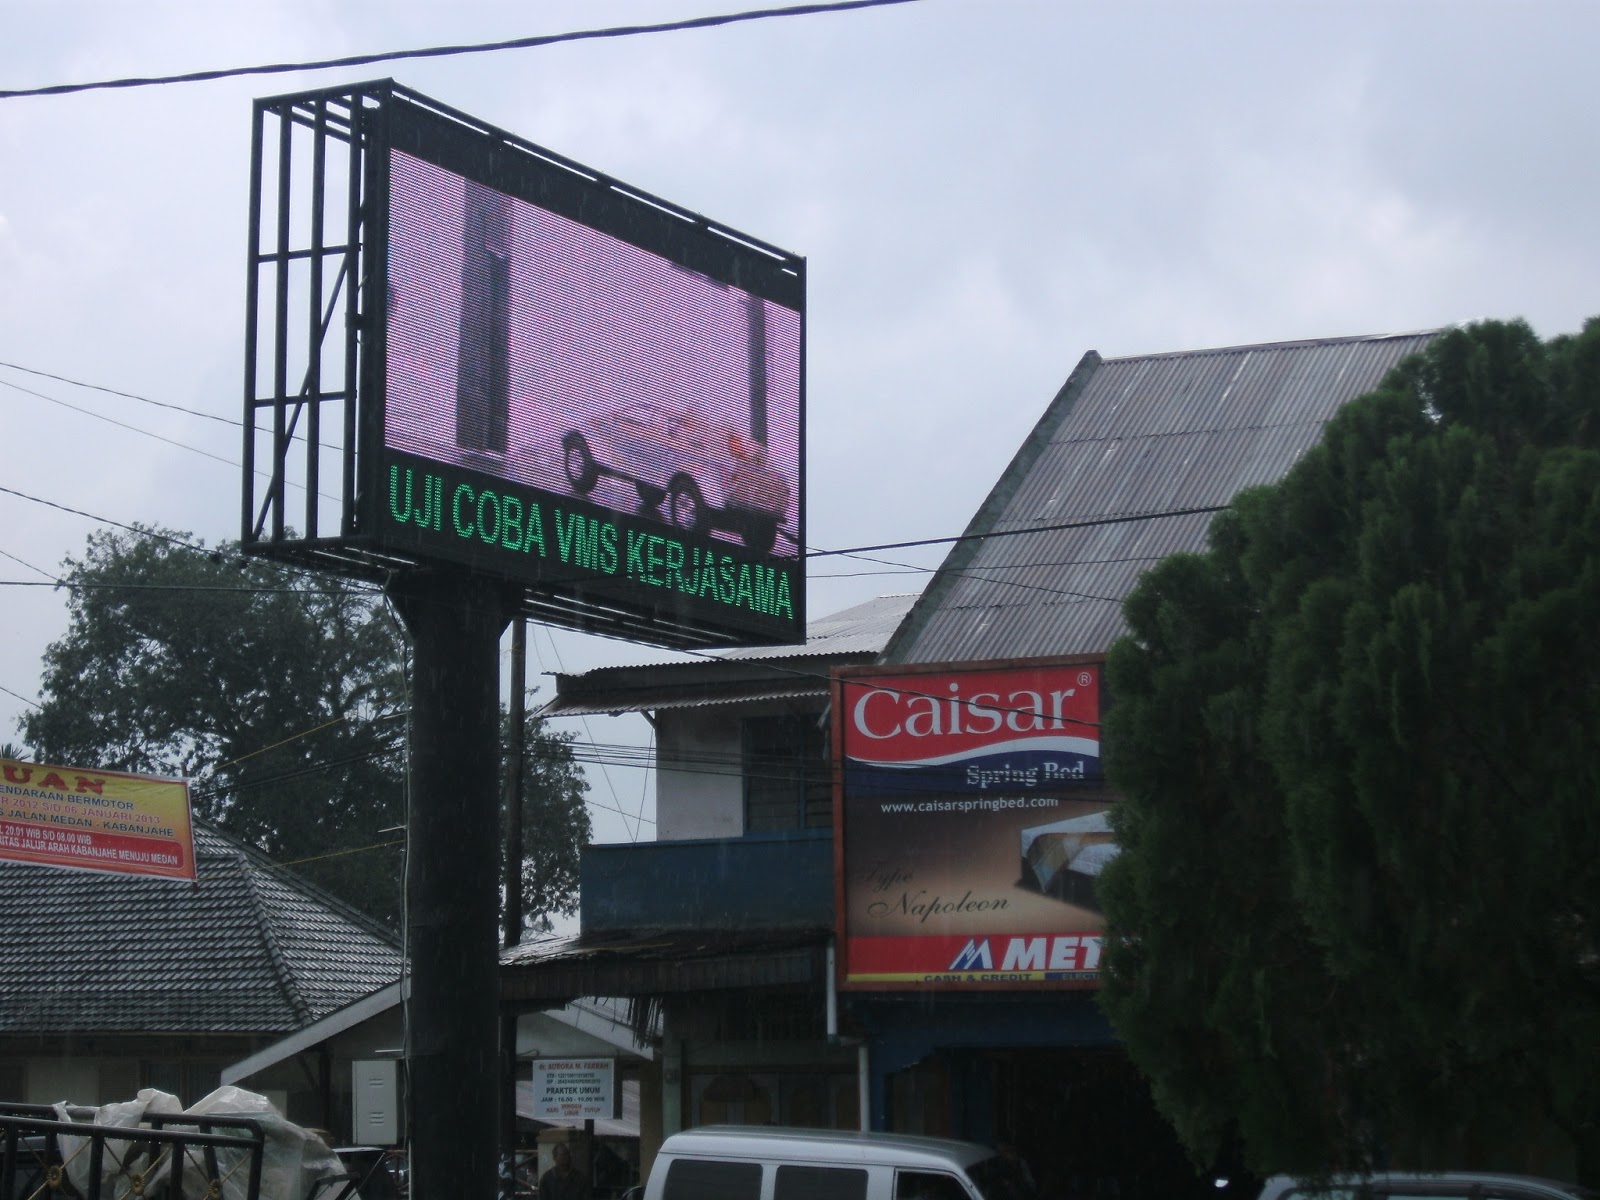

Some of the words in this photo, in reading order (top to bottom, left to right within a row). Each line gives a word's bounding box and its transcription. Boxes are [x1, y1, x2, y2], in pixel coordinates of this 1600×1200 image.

[389, 464, 443, 531] UJI
[452, 482, 546, 557] COBA
[554, 507, 618, 575] VMS
[626, 528, 794, 620] KERJASAMA
[853, 682, 1076, 740] Caisar
[966, 763, 1038, 789] Spring
[13, 798, 38, 809] 2012
[42, 802, 61, 813] S/D
[81, 808, 132, 822] JANUARI
[135, 814, 161, 825] 2013
[67, 794, 134, 811] BERMOTOR
[880, 796, 1059, 814] www.caisarspringbed.com
[8, 809, 47, 822] JALAN
[50, 815, 92, 828] MEDAN
[103, 821, 175, 837] KABANJAHE
[26, 828, 41, 840] WIB
[77, 834, 92, 845] WIB
[21, 838, 47, 851] JALUR
[47, 841, 70, 853] ARAH
[70, 844, 117, 860] KABANJAHE
[119, 850, 150, 863] MENUJU
[151, 853, 178, 866] MEDAN
[867, 889, 1010, 924] Napoleon
[924, 974, 962, 983] CASH
[967, 974, 977, 982] &
[981, 973, 1033, 982] CREDIT
[546, 1087, 578, 1095] PRAKTEK
